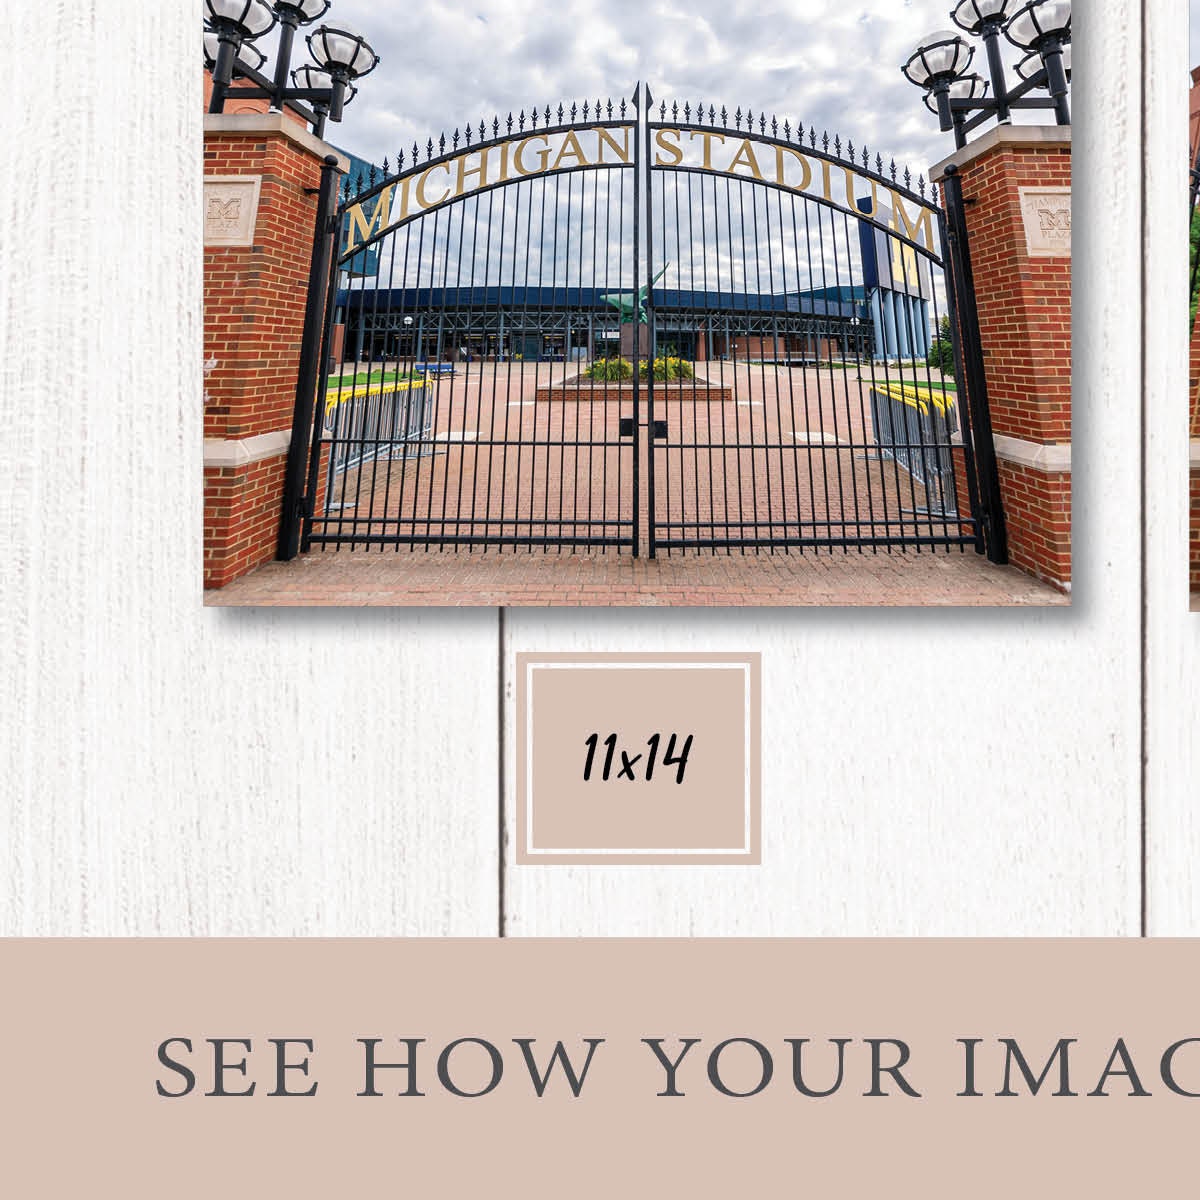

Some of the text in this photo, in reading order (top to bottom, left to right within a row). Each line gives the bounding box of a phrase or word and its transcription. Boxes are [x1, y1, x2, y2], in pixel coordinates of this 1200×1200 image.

[207, 198, 242, 220] M
[342, 126, 937, 256] MICHIGAN STADIUM
